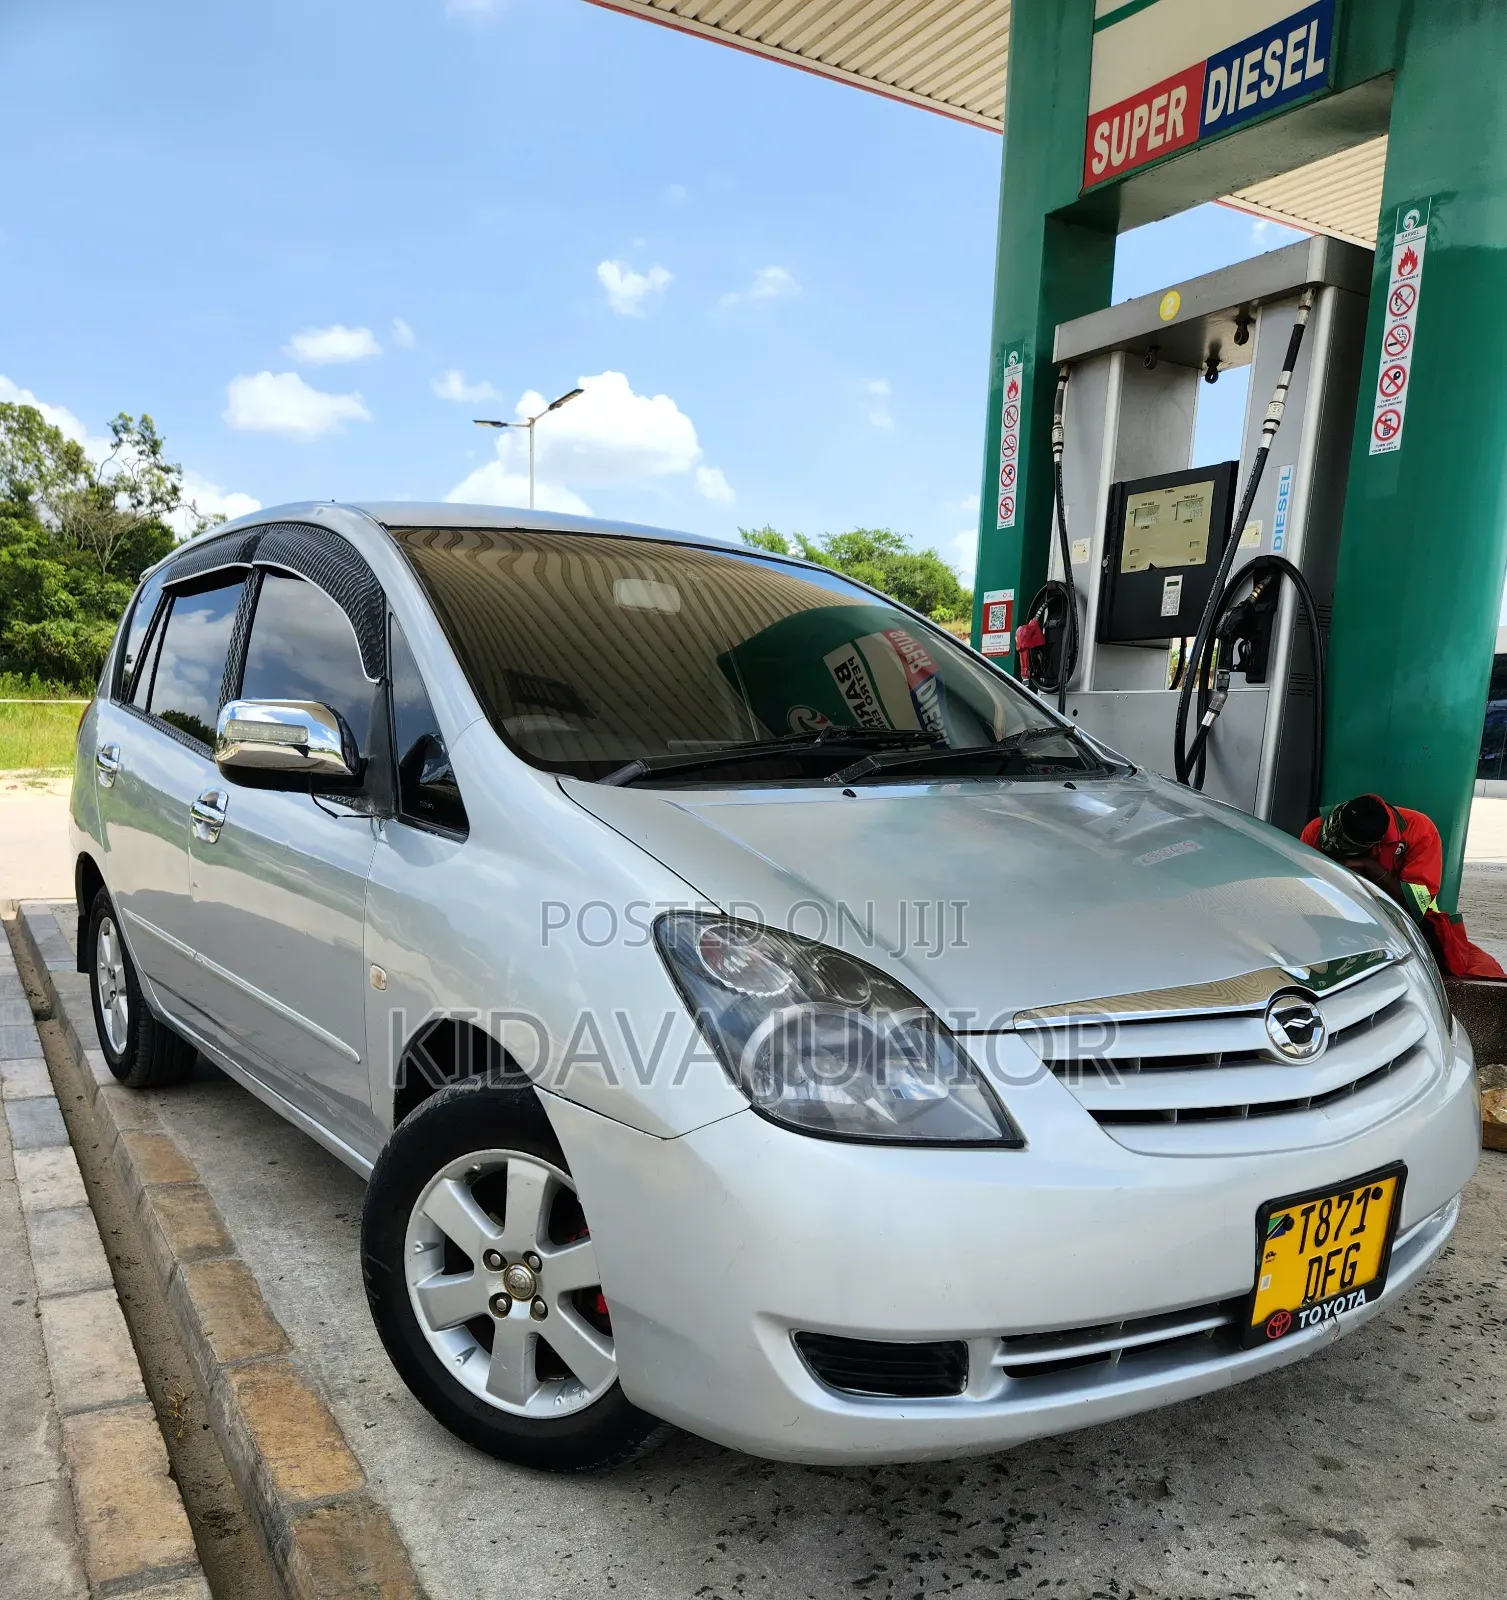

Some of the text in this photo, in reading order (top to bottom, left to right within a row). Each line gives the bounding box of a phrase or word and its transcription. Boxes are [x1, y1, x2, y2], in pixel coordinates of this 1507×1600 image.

[1091, 18, 1325, 175] SUPER DIESEL
[1164, 296, 1175, 316] 2
[1273, 467, 1292, 551] DIESEL
[1299, 1187, 1372, 1255] T871
[1302, 1241, 1361, 1302] DFG
[1299, 1288, 1367, 1329] TOYOTA
